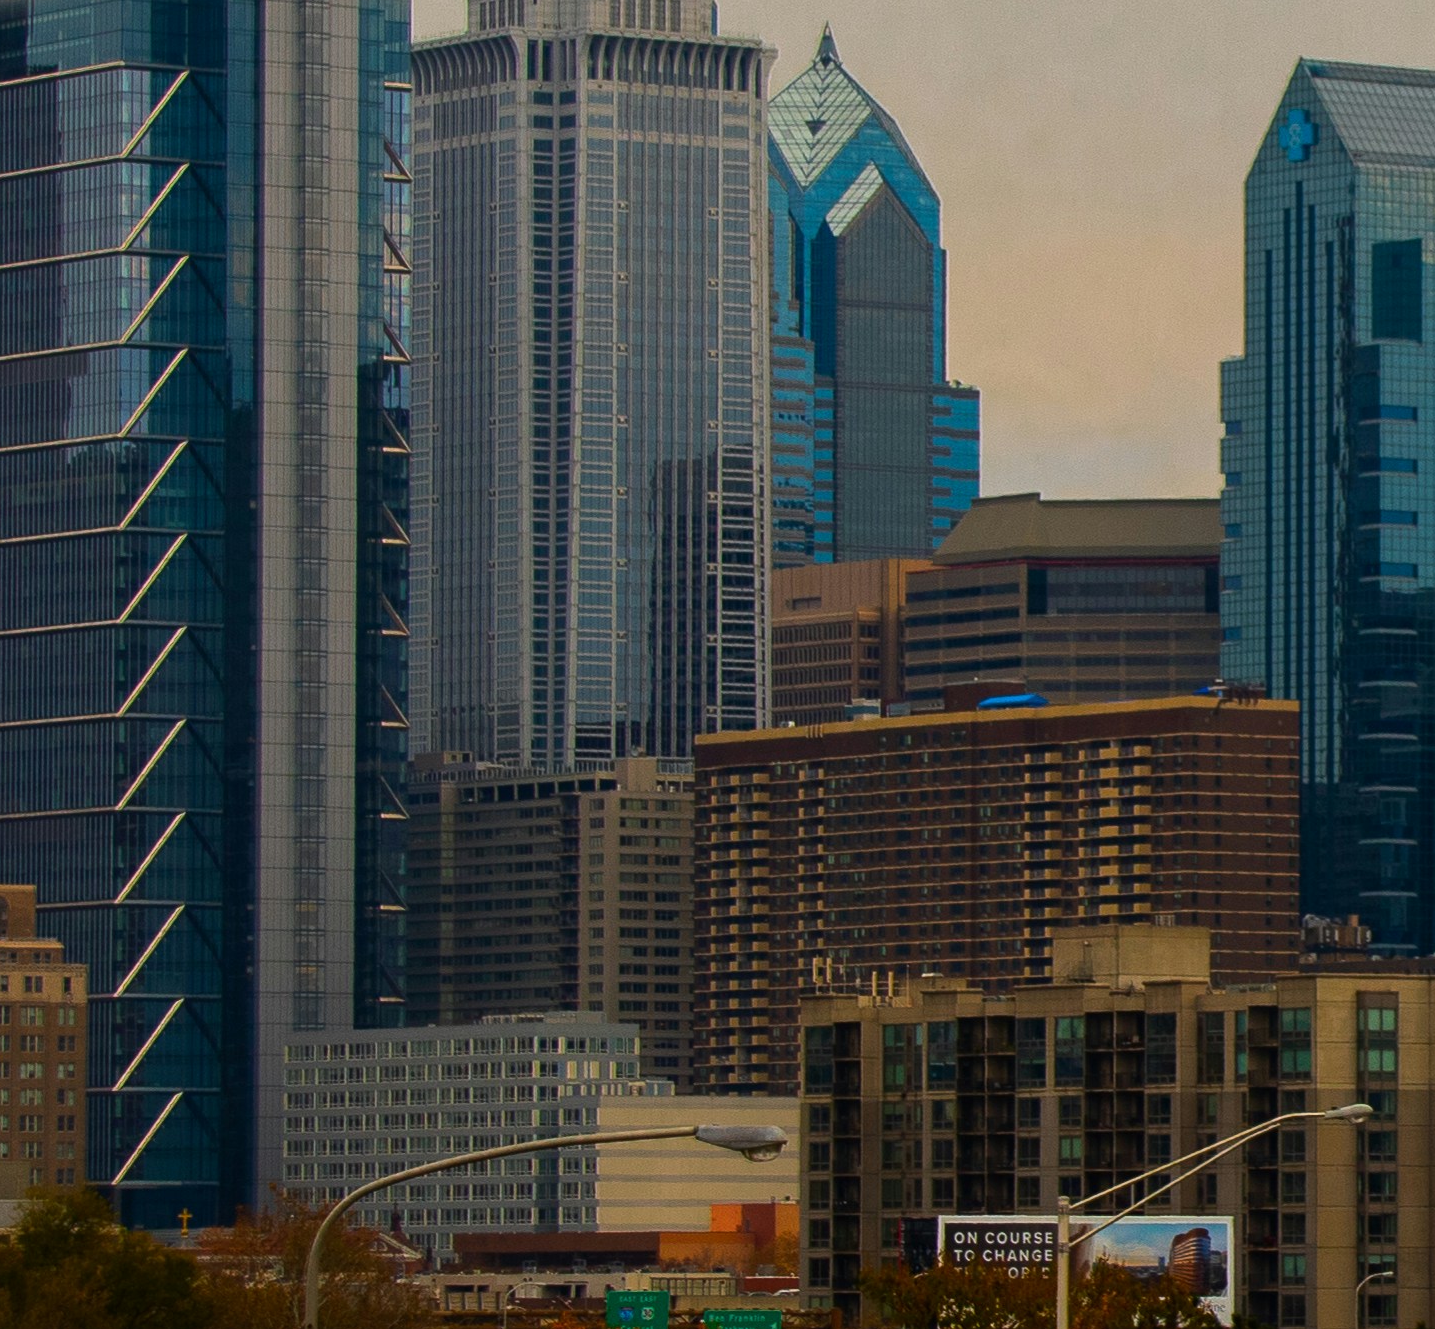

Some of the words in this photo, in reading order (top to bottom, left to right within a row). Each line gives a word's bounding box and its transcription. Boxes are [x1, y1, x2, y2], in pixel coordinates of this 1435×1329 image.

[953, 1231, 977, 1245] ON
[985, 1231, 1053, 1245] COURSE
[953, 1249, 975, 1263] TO
[982, 1249, 1053, 1262] CHANGE
[729, 1314, 766, 1322] Franklin
